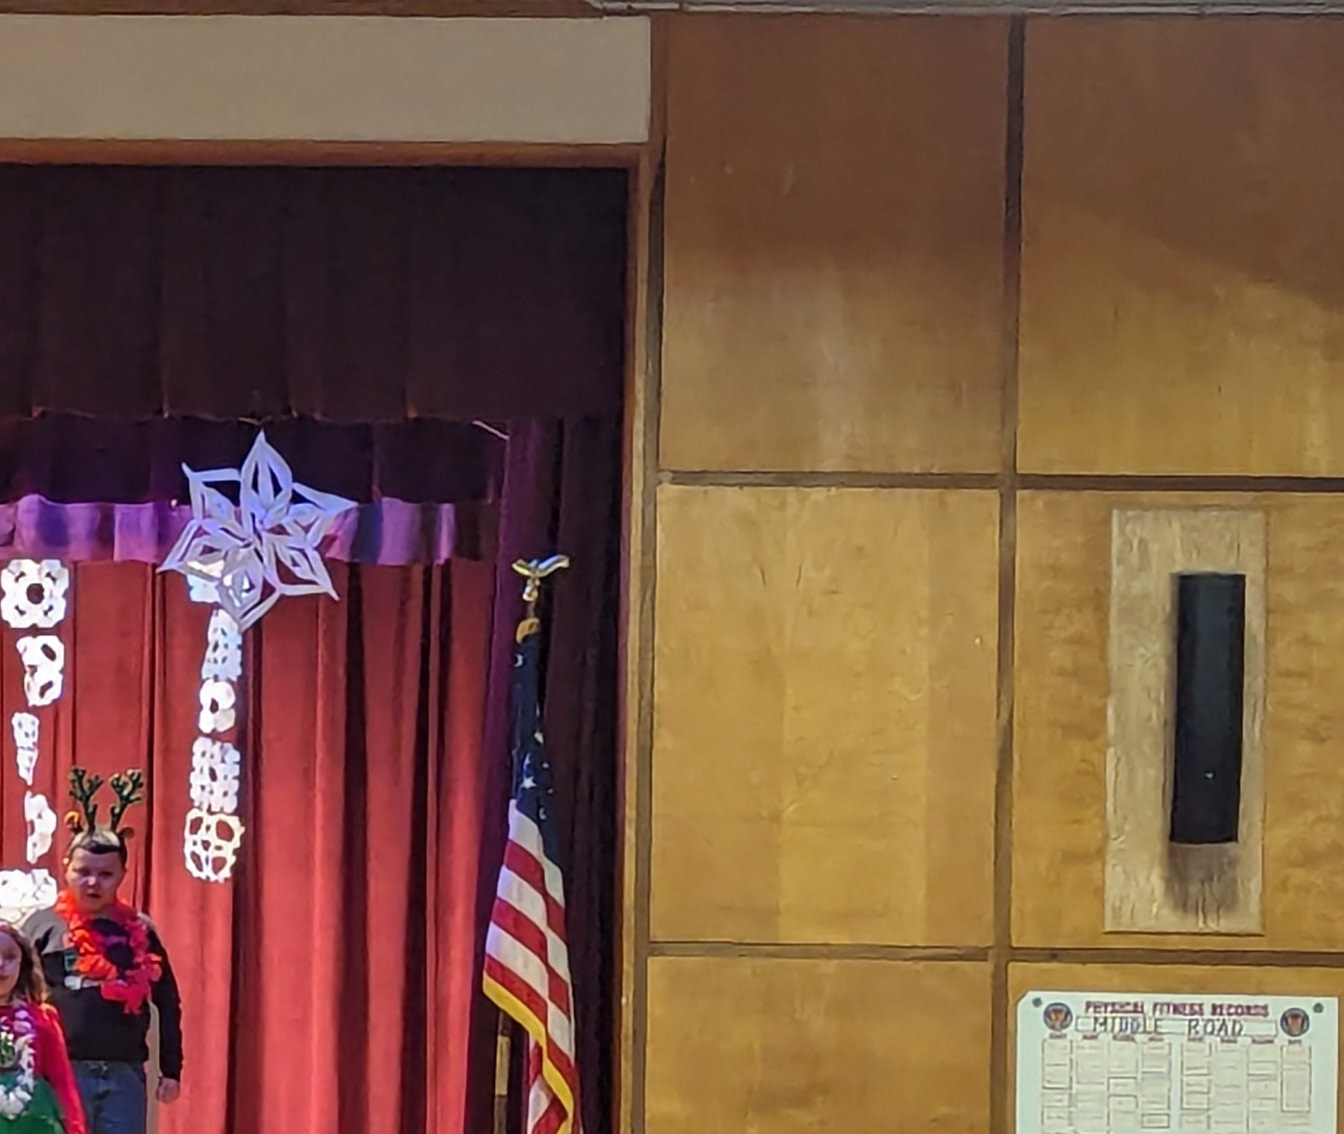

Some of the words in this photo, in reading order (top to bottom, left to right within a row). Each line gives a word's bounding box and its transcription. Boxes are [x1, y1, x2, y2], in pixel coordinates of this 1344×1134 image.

[1152, 1003, 1204, 1016] FITNESS
[1211, 1003, 1269, 1017] RECORDS
[1187, 1018, 1243, 1036] ROAD
